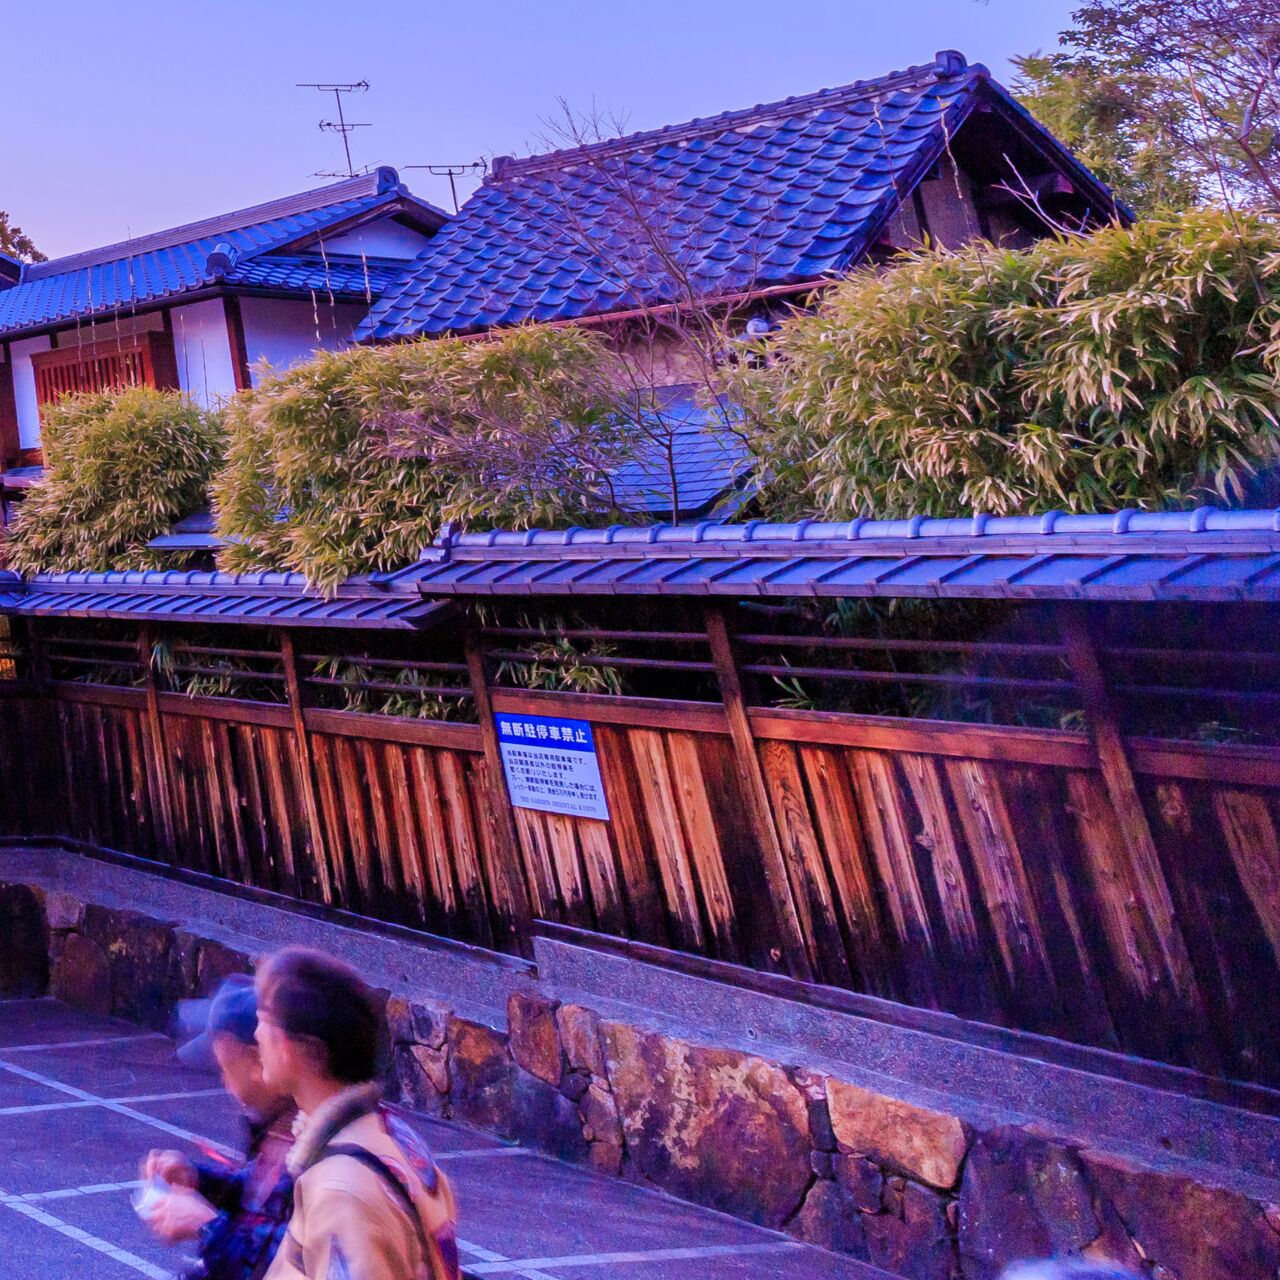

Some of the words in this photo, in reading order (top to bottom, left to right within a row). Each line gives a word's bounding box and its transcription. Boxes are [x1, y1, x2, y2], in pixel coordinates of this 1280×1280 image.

[500, 721, 587, 743] 無断駐停車禁止
